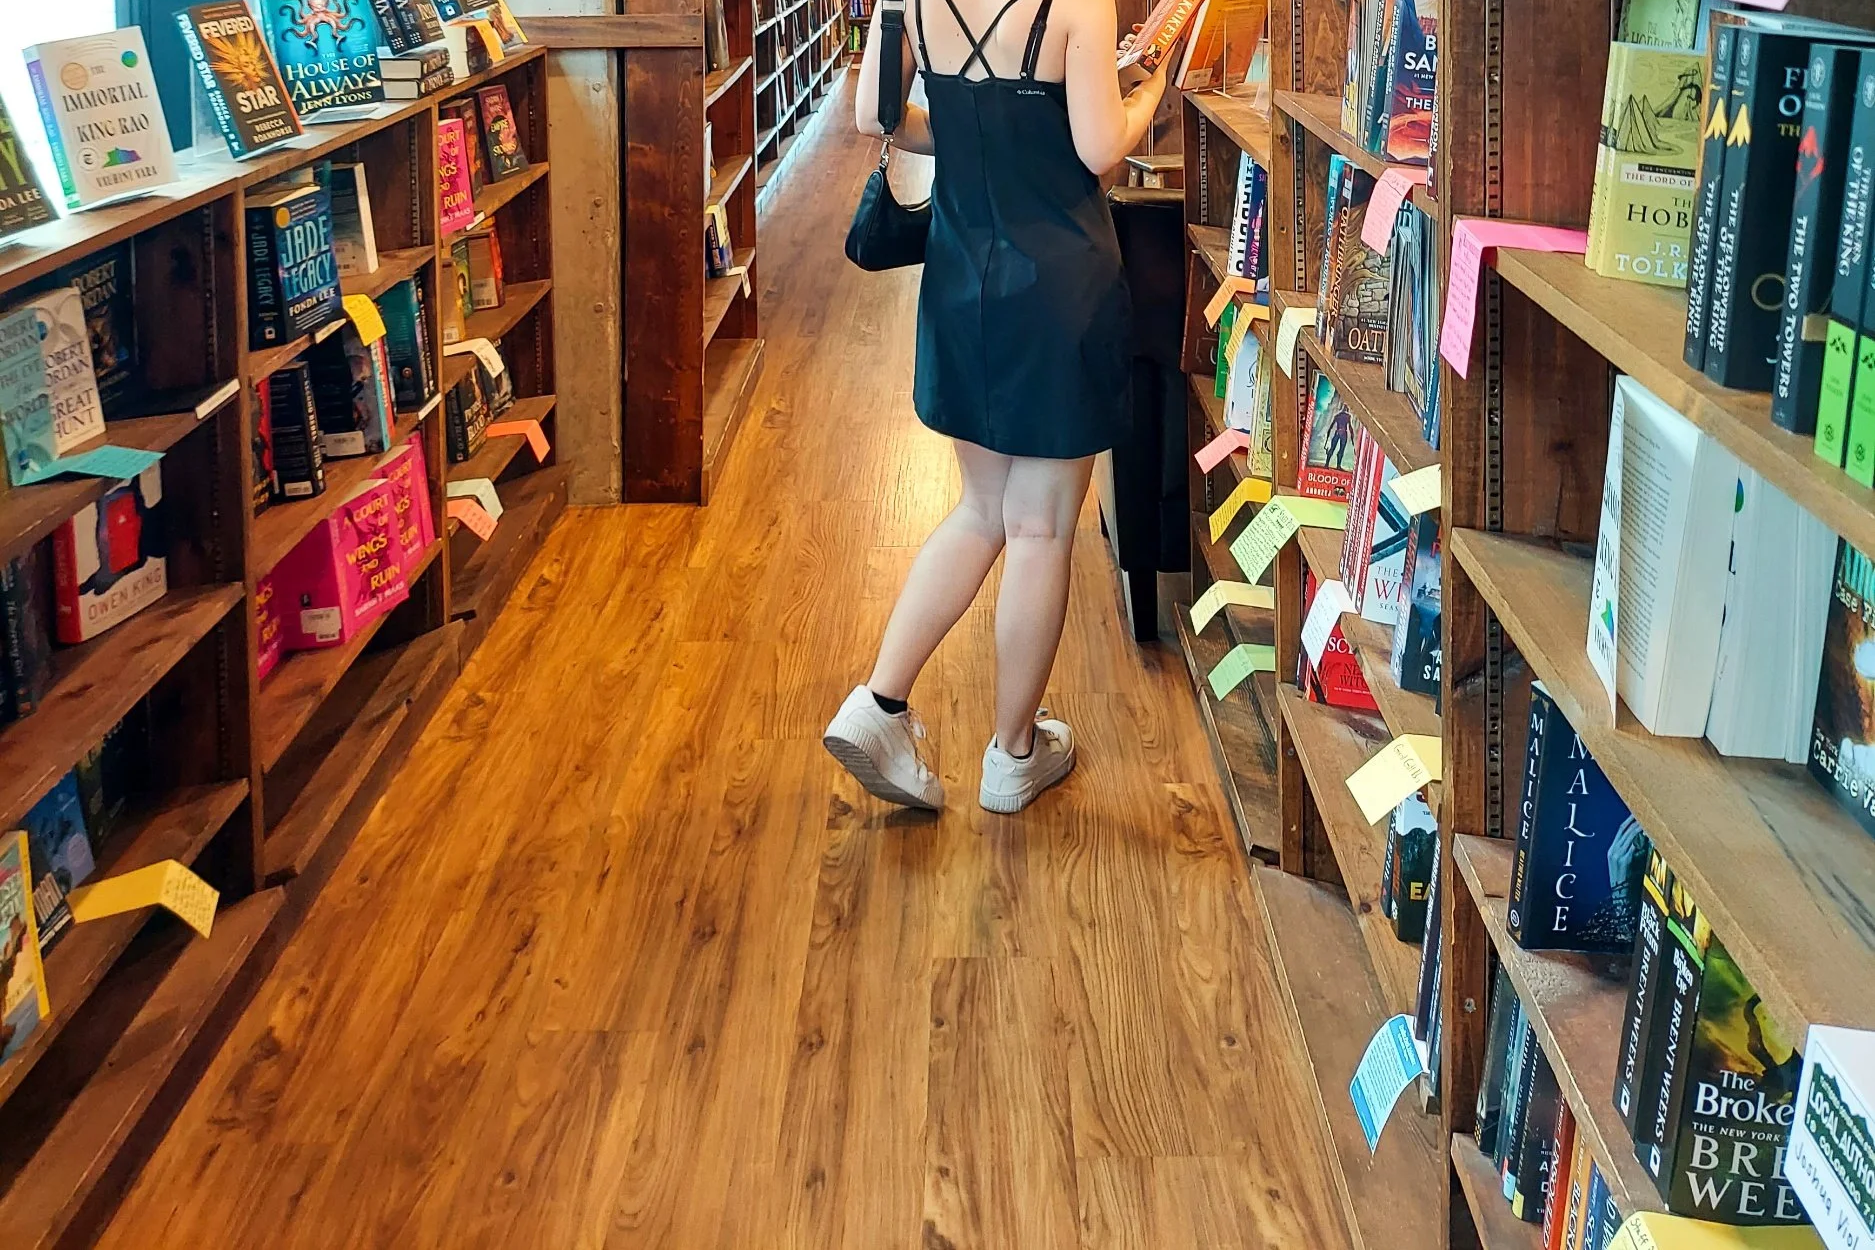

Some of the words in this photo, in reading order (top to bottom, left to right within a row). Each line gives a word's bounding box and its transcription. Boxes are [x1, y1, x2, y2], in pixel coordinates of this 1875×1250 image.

[198, 16, 255, 40] FEVERED
[1157, 0, 1192, 46] KAIKEYI
[177, 14, 204, 61] FEVERED
[197, 61, 217, 91] STAR
[285, 58, 350, 81] HOUSE
[352, 54, 376, 68] OF
[62, 82, 148, 112] IMMORTAL
[236, 85, 281, 114] STAR
[292, 70, 382, 101] ALWAYS
[300, 97, 333, 114] JENN
[335, 91, 372, 106] LYONS
[1405, 96, 1433, 111] THE
[76, 119, 116, 143] KING
[119, 113, 150, 135] RAO
[254, 118, 285, 133] REBECCA
[438, 130, 461, 145] OURT
[134, 165, 158, 181] VARA
[1850, 146, 1865, 174] OF
[17, 188, 41, 204] LEE
[1625, 171, 1645, 182] THE
[1648, 174, 1676, 185] LORD
[1679, 178, 1693, 187] OF
[1858, 167, 1872, 199] THE
[444, 190, 468, 209] RUIN
[1627, 203, 1689, 229] HOB
[1671, 196, 1691, 209] TH
[1704, 181, 1715, 218] THE
[1728, 190, 1739, 228] THE
[1844, 180, 1860, 222] THE
[281, 215, 331, 269] JADE
[1696, 216, 1704, 242] OF
[1719, 226, 1729, 253] OF
[1793, 215, 1808, 258] THE
[1852, 200, 1868, 267] RETURN
[252, 233, 269, 263] JADE
[1330, 206, 1349, 318] OATHBRINGER
[1615, 253, 1689, 280] TOLK
[1692, 246, 1701, 282] THE
[1838, 222, 1855, 278] KING
[255, 266, 275, 306] LEGACY
[283, 251, 333, 301] LEGACY
[1693, 221, 1711, 339] FELLOWSHIP
[1714, 256, 1725, 296] THE
[1716, 231, 1735, 354] FELLOWSHIP
[1788, 261, 1803, 310] TWO
[289, 296, 318, 317] FONDA
[319, 287, 337, 302] LEE
[1778, 314, 1797, 399] TOWERS
[1305, 486, 1332, 497] ANDRZEJ
[1307, 472, 1339, 485] BLOOD
[1341, 478, 1351, 487] OF
[353, 493, 391, 522] COURT
[346, 533, 389, 566] WINGS
[370, 563, 402, 590] RUIN
[1376, 565, 1398, 578] THE
[88, 586, 129, 621] OWEN
[132, 567, 163, 599] KING
[1379, 602, 1400, 611] SEAS
[1834, 578, 1859, 613] Case
[1521, 713, 1544, 840] MALICE
[1813, 737, 1860, 800] Carrie
[1552, 733, 1595, 932] MALICE
[1428, 837, 1441, 893] DEADBEAT
[1639, 920, 1660, 957] Prism
[1640, 900, 1661, 941] Black
[1635, 945, 1653, 1017] BRENT
[1673, 947, 1693, 988] Broken
[1676, 973, 1688, 997] Eye
[1625, 1016, 1643, 1084] WEEKS
[1666, 997, 1684, 1073] BRENT
[1719, 1068, 1755, 1092] The
[1514, 1083, 1524, 1125] MARTHA
[1654, 1072, 1673, 1143] WEEKS
[1694, 1081, 1795, 1126] Broke
[1808, 1080, 1841, 1144] LOCAL
[1509, 1127, 1518, 1160] WELLS
[1692, 1121, 1715, 1134] THE
[1719, 1126, 1748, 1139] NEW
[1750, 1130, 1781, 1143] YORK
[1689, 1133, 1787, 1181] BRE
[1818, 1135, 1862, 1206] COLORADO
[1543, 1137, 1561, 1248] UNSOULED
[1685, 1171, 1802, 1221] WEE
[1794, 1141, 1834, 1217] Joshua
[1566, 1179, 1582, 1250] BLACK
[1630, 1216, 1650, 1247] Staff
